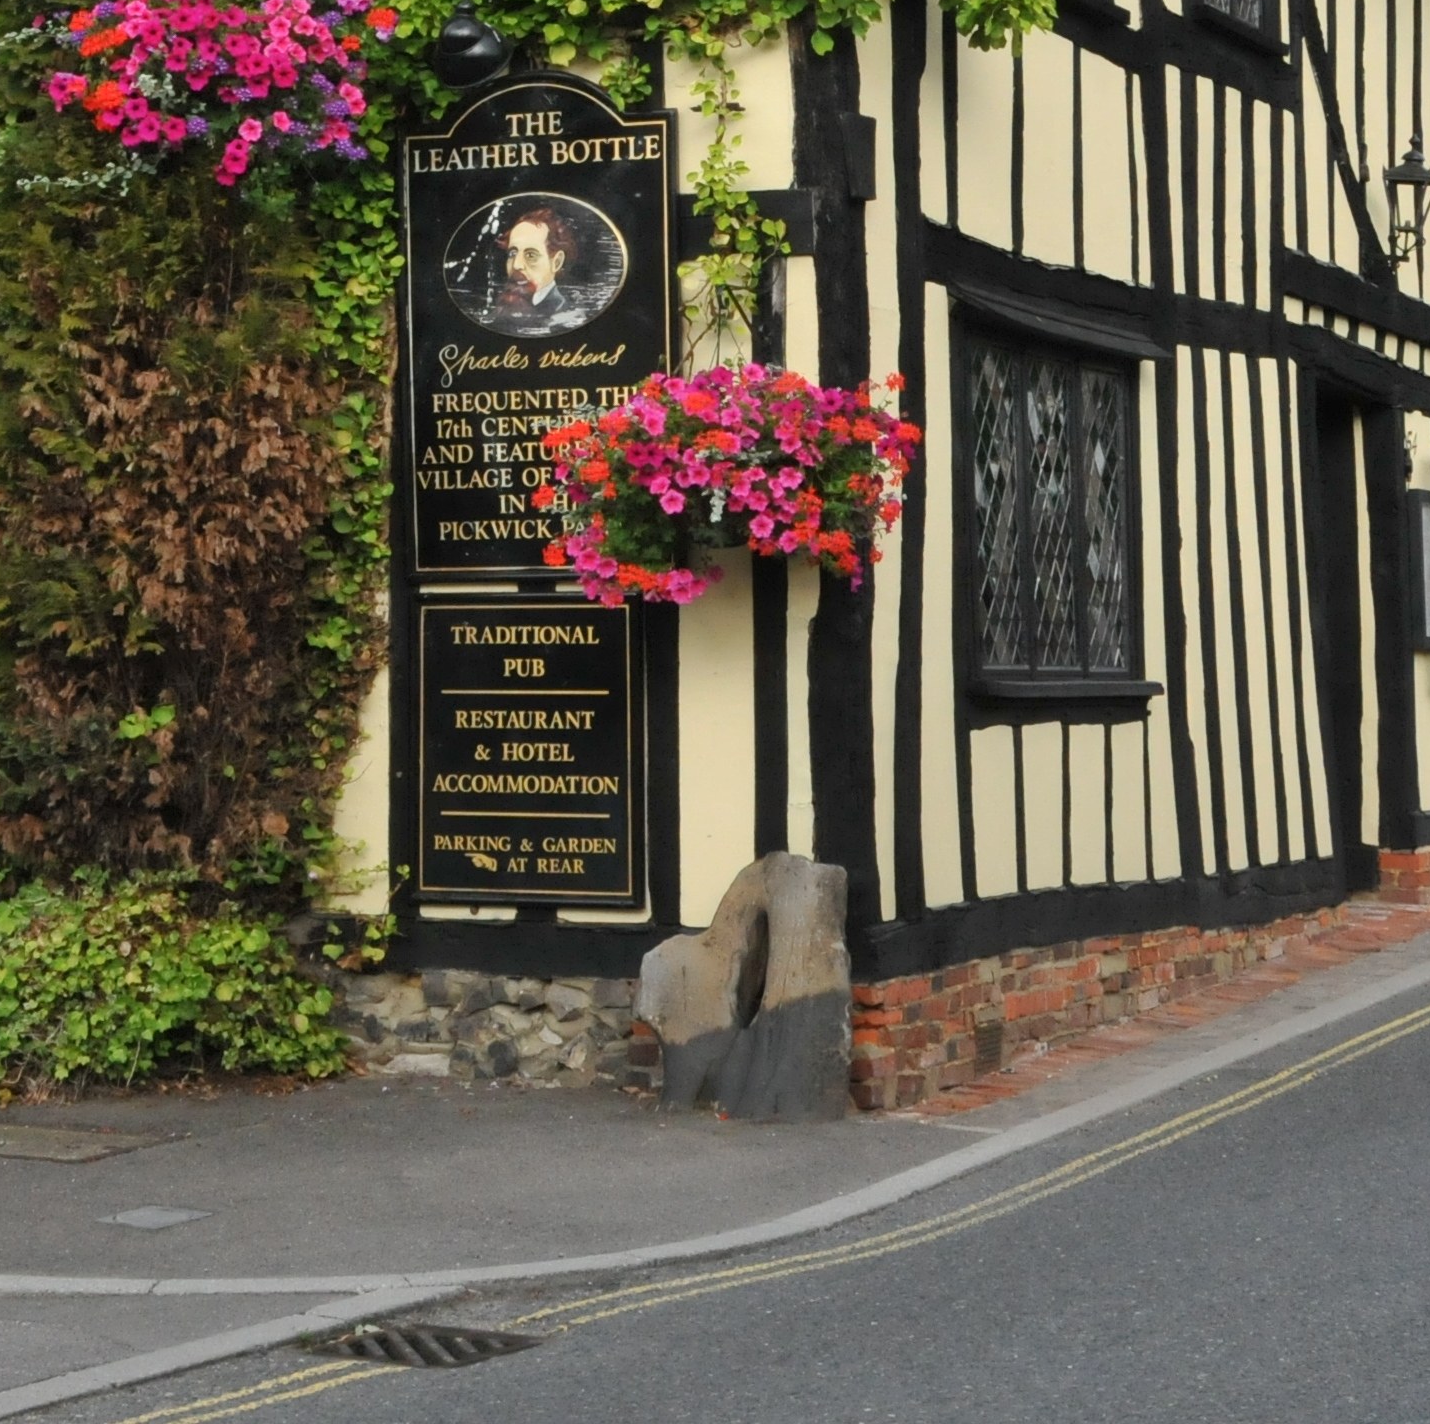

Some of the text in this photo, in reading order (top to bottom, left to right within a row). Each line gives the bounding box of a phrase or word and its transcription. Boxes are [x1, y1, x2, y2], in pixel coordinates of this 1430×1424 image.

[506, 111, 563, 137] THE
[413, 135, 661, 174] LEATHER BOTTLE
[538, 344, 626, 368] Dickens
[432, 386, 637, 414] FREQUENTED THI
[436, 419, 473, 439] 17th
[422, 445, 473, 465] AND
[417, 467, 552, 490] VILLAGE OF
[499, 494, 525, 514] IN
[439, 519, 552, 541] PICKWICK
[451, 626, 599, 645] TRADITIONAL
[503, 659, 545, 677] PUB
[455, 711, 594, 729] RESTAURANT
[474, 743, 574, 761] & HOTEL
[432, 774, 619, 794] ACCOMMODATION
[434, 835, 616, 853] PARKING & GARDEN
[508, 859, 584, 873] AT REAR
